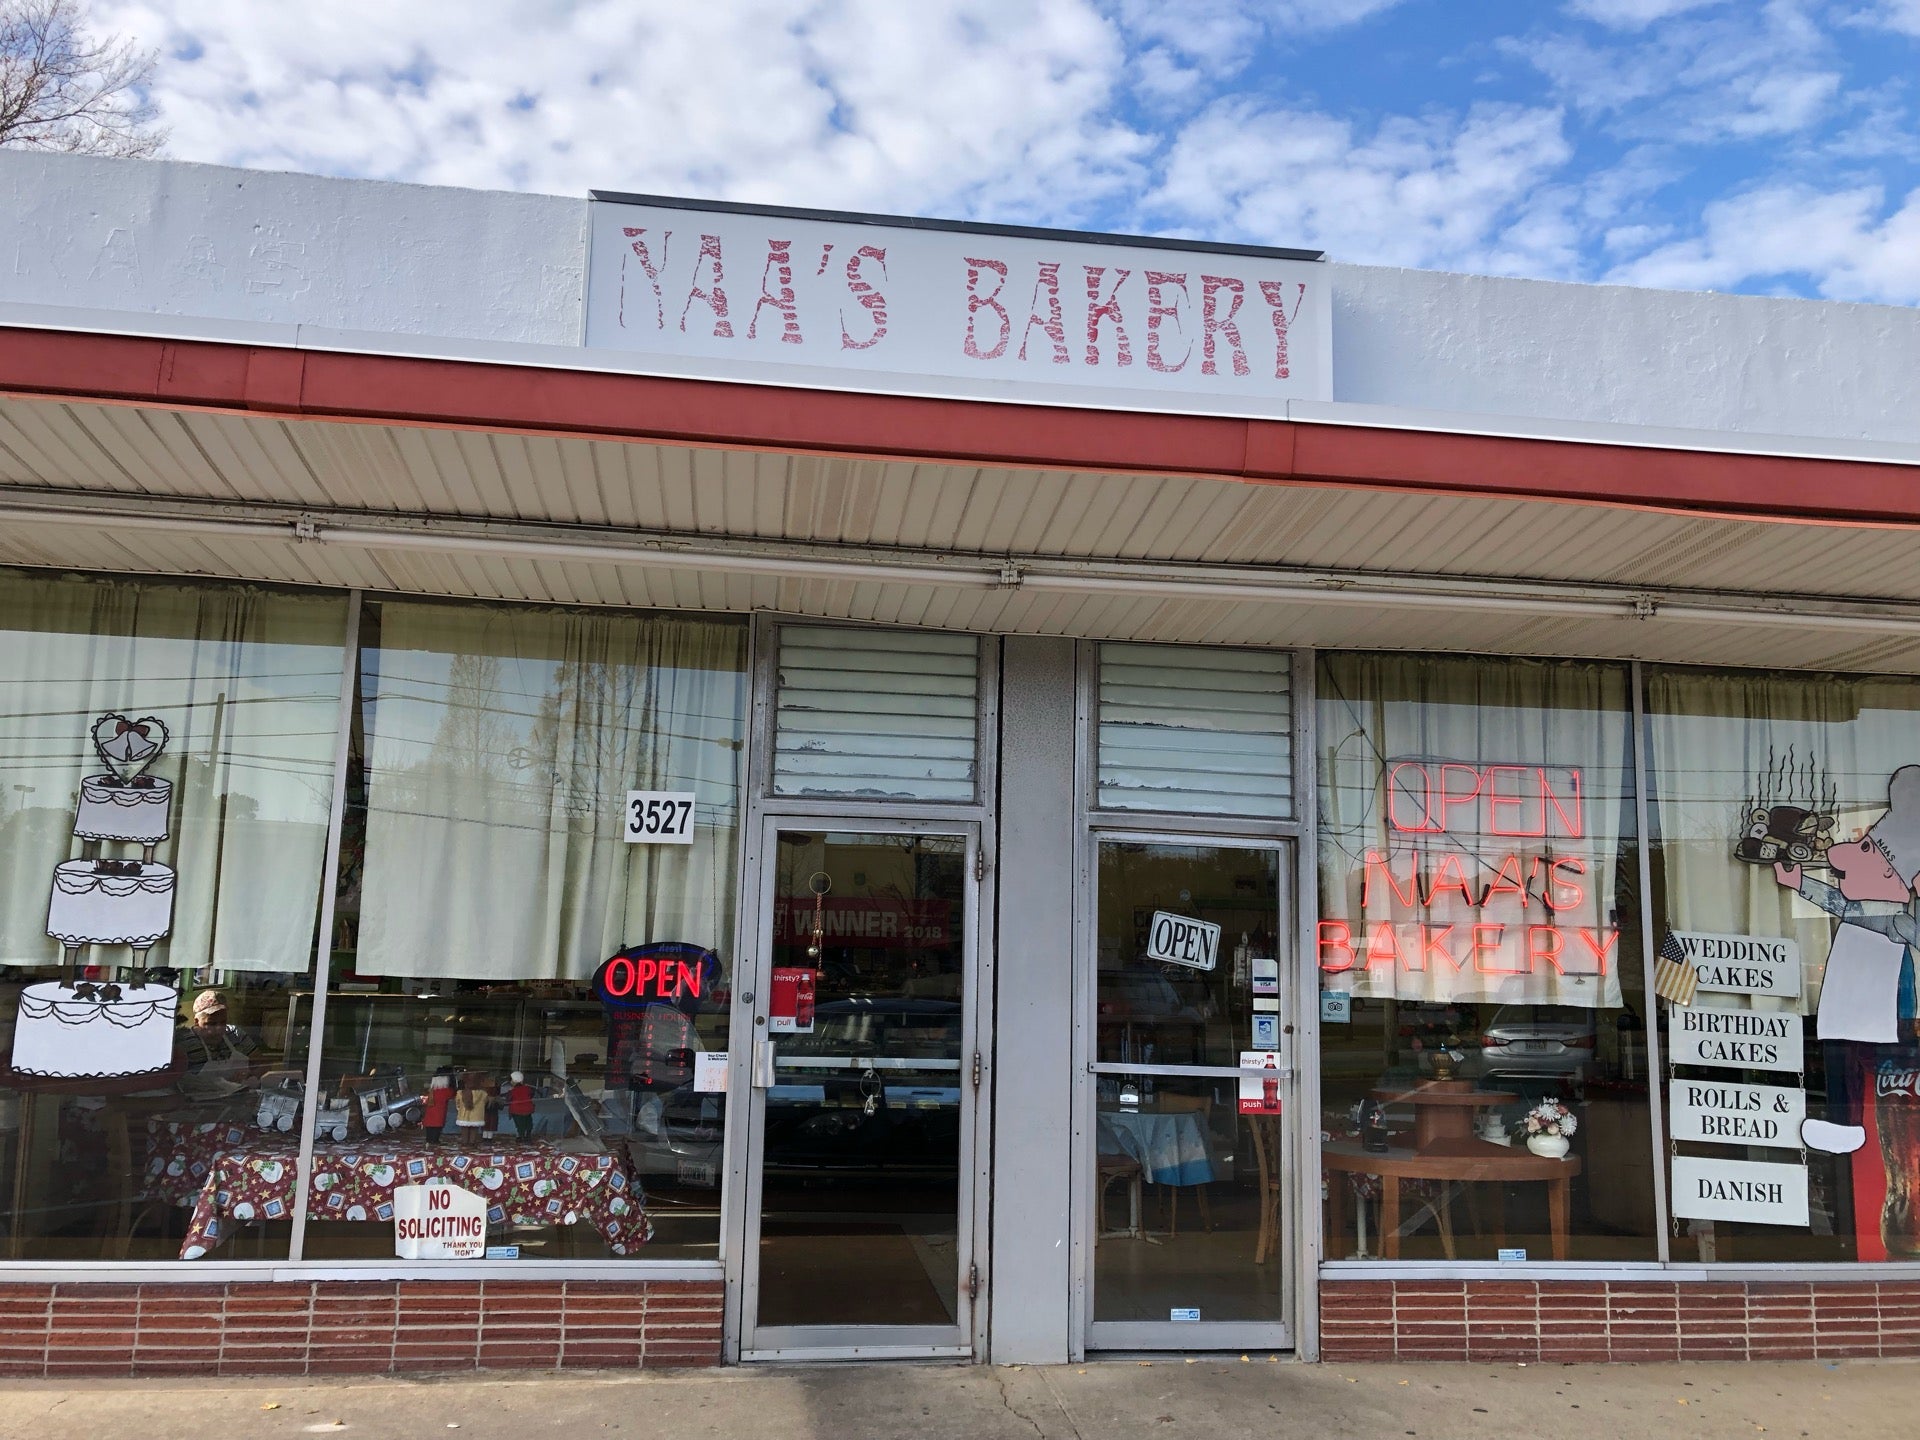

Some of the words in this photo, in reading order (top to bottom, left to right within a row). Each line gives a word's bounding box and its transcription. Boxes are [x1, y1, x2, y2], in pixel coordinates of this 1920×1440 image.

[621, 226, 889, 352] NAA'S
[962, 255, 1306, 379] BAKERY
[1389, 762, 1582, 837] OPEN
[629, 798, 692, 834] 3527
[1876, 838, 1896, 861] NAAS
[1361, 850, 1585, 910] NAA'S
[793, 909, 898, 938] WINNER
[904, 926, 942, 939] 2018
[1154, 918, 1215, 965] OPEN
[1316, 920, 1620, 976] BAKERY
[1681, 937, 1787, 963] WEDDING
[603, 957, 703, 998] OPEN
[773, 974, 800, 983] thirsty?
[1696, 964, 1774, 988] CAKES
[613, 1012, 655, 1022] BUSINESS
[776, 1019, 791, 1027] pull
[1683, 1011, 1791, 1038] BIRTHDAY
[1241, 1058, 1265, 1066] thirsty?
[1697, 1039, 1778, 1064] CAKES
[1242, 1100, 1262, 1109] push
[1687, 1087, 1762, 1112] ROLLS
[1773, 1093, 1791, 1113] &
[1701, 1115, 1778, 1139] BREAD
[429, 1189, 451, 1211] NO
[1697, 1178, 1784, 1204] DANISH
[398, 1216, 482, 1240] SOLICITING
[442, 1241, 467, 1249] THANK
[469, 1241, 483, 1249] YOU
